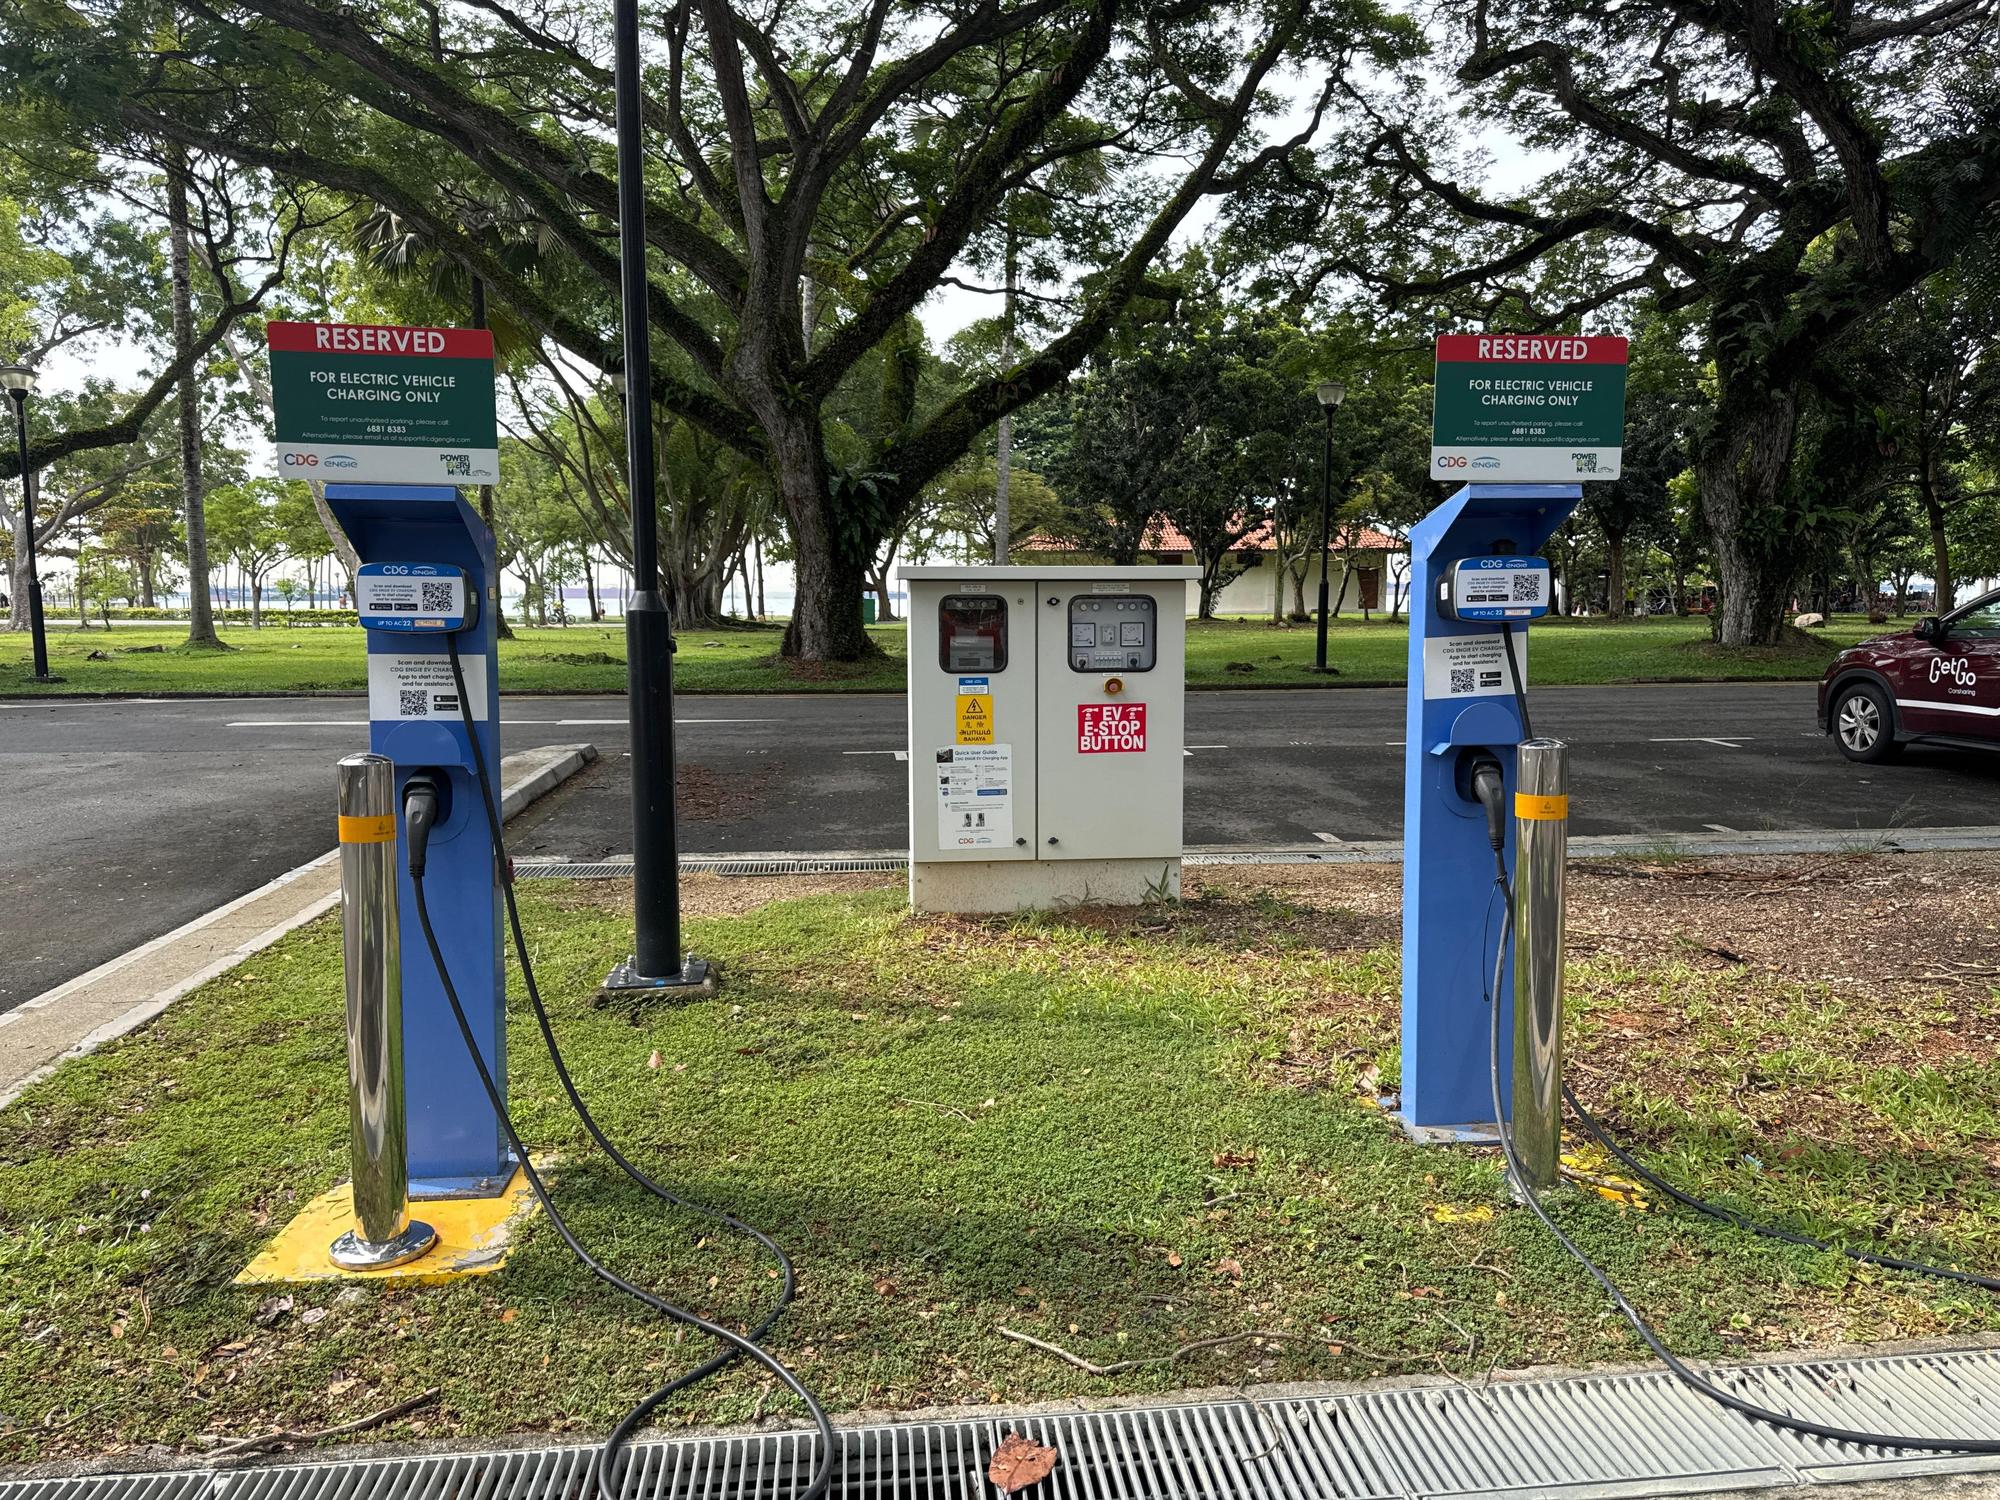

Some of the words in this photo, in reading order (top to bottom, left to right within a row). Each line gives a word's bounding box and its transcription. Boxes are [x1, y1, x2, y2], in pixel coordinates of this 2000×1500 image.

[316, 327, 446, 353] RESERVED
[1478, 338, 1588, 360] RESERVED
[310, 371, 336, 383] FOR
[340, 372, 399, 386] ELECTRIC
[402, 374, 456, 388] VEHICLE
[1469, 379, 1492, 390] FOR
[1494, 380, 1545, 391] ELECTRIC
[1548, 380, 1592, 392] VEHICLE
[326, 388, 402, 402] CHARGING
[405, 392, 441, 403] ONLY
[1482, 394, 1545, 406] CHARGING
[1548, 396, 1579, 406] ONLY
[284, 454, 319, 466] CDG
[1438, 456, 1468, 468] CDG
[383, 566, 409, 574] CDG
[1480, 560, 1503, 568] CDG
[1929, 656, 1976, 686] GetGo
[1948, 688, 1976, 696] Carsharing
[1102, 706, 1122, 720] EV
[1084, 720, 1141, 736] E-STOP
[1080, 735, 1144, 751] BUTTON
